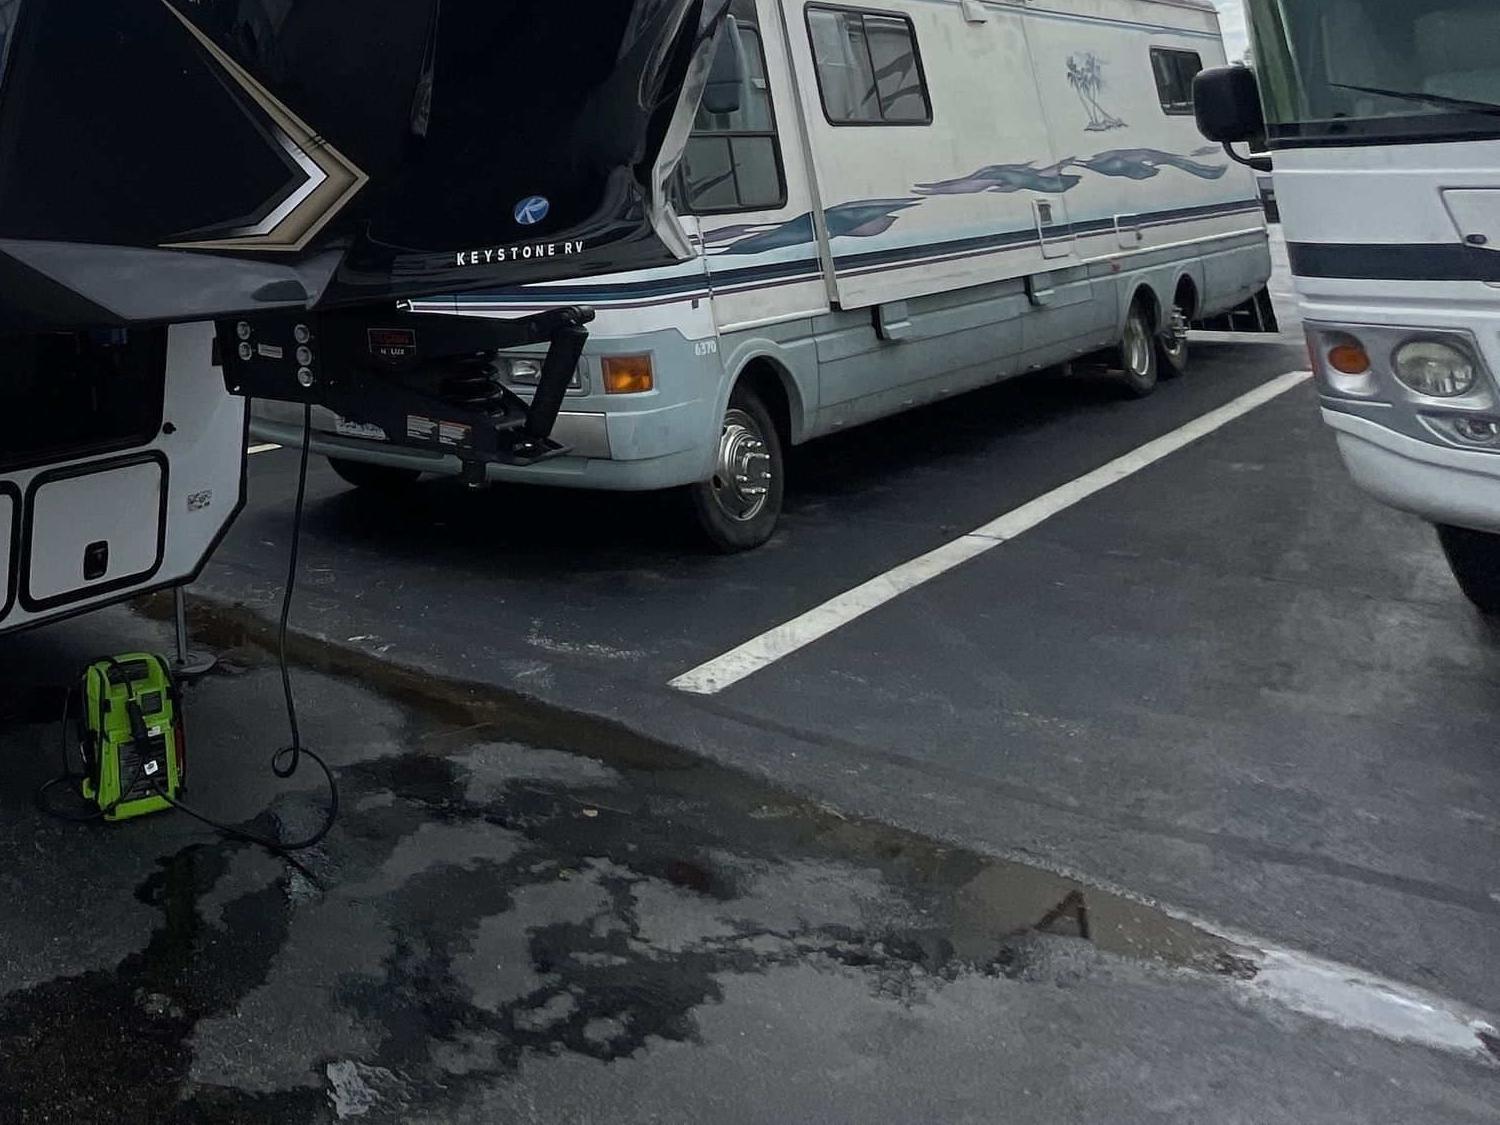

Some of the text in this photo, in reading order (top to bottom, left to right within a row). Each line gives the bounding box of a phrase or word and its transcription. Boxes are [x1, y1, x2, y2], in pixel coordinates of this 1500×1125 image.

[456, 241, 584, 266] KEYSTONE RV
[695, 340, 717, 356] 6370
